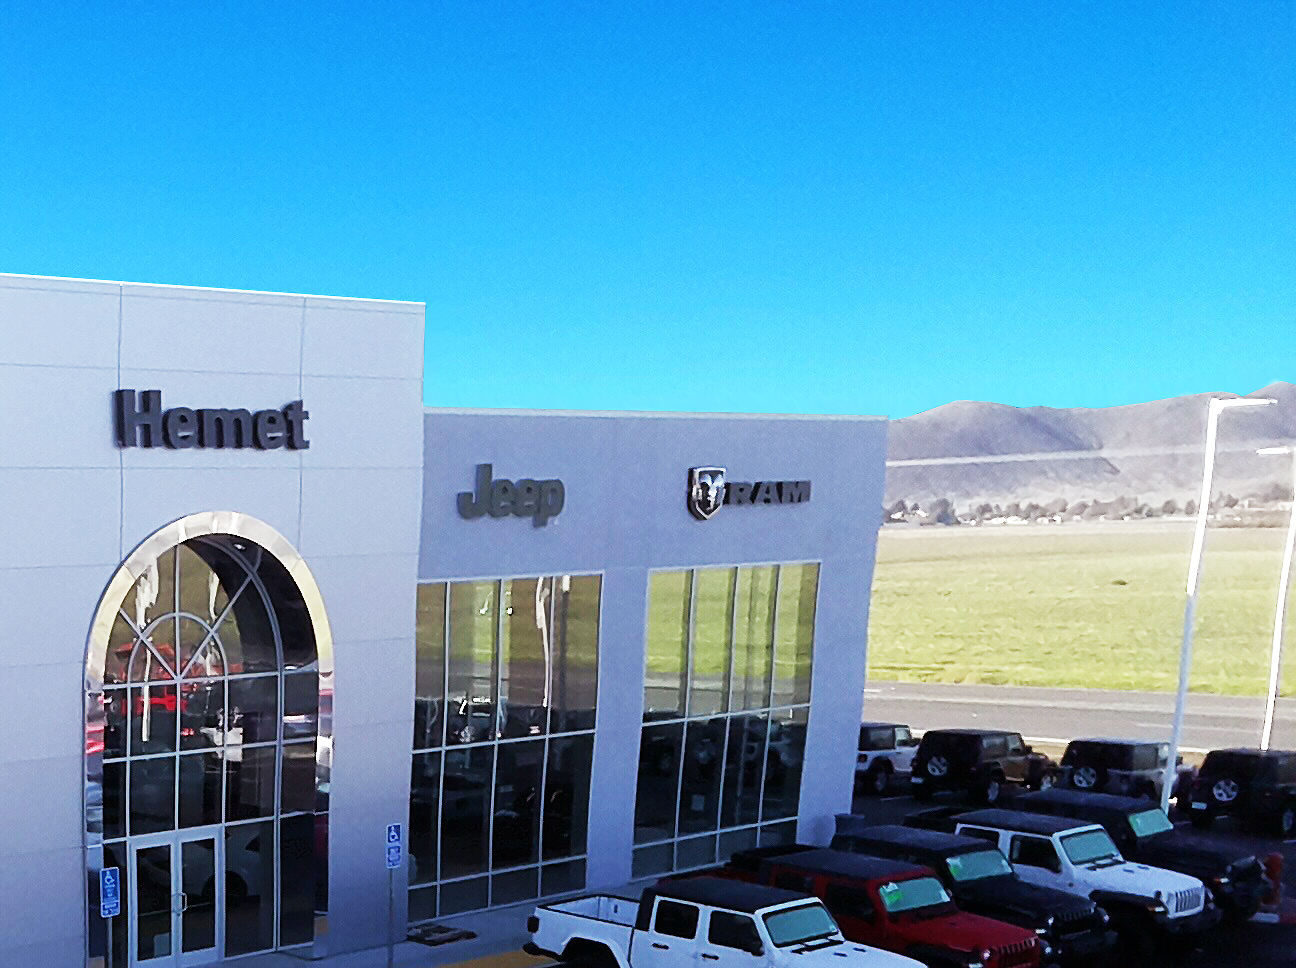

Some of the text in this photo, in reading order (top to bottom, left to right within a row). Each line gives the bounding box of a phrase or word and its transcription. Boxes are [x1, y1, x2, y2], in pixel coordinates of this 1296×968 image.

[112, 389, 310, 450] Hemet
[456, 463, 565, 528] Jeep
[723, 481, 811, 505] RAM
